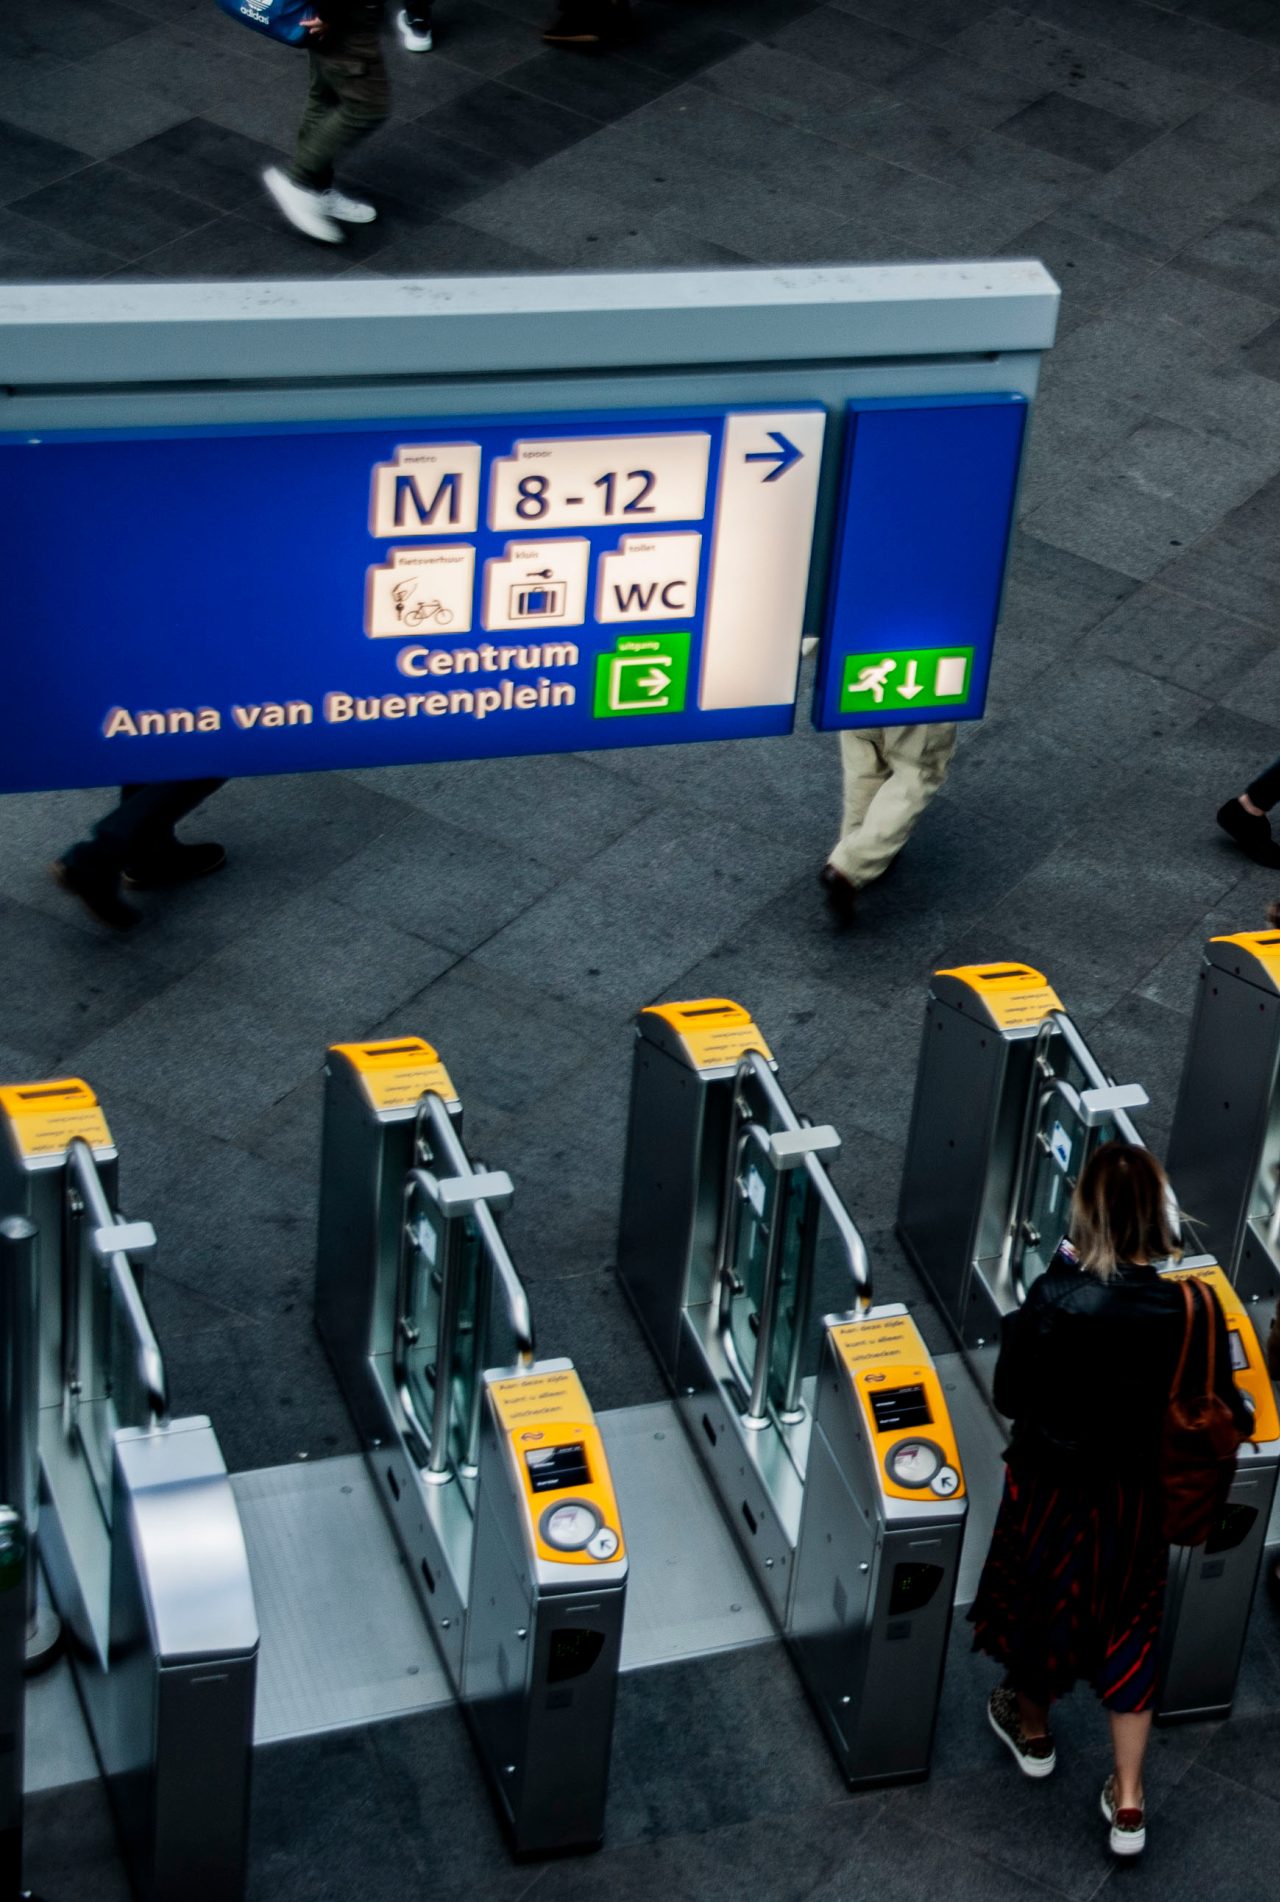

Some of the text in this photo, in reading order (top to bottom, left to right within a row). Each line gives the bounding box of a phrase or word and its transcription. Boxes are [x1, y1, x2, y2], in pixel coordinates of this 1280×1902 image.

[240, 6, 270, 25] adidas
[403, 454, 437, 464] metro
[522, 450, 553, 460] spoor
[393, 472, 463, 527] M
[628, 543, 656, 553] toilet
[613, 579, 688, 613] WC
[618, 641, 661, 653] uitgang
[397, 642, 579, 677] Centrum
[103, 677, 577, 738] Anna van Buerenplein
